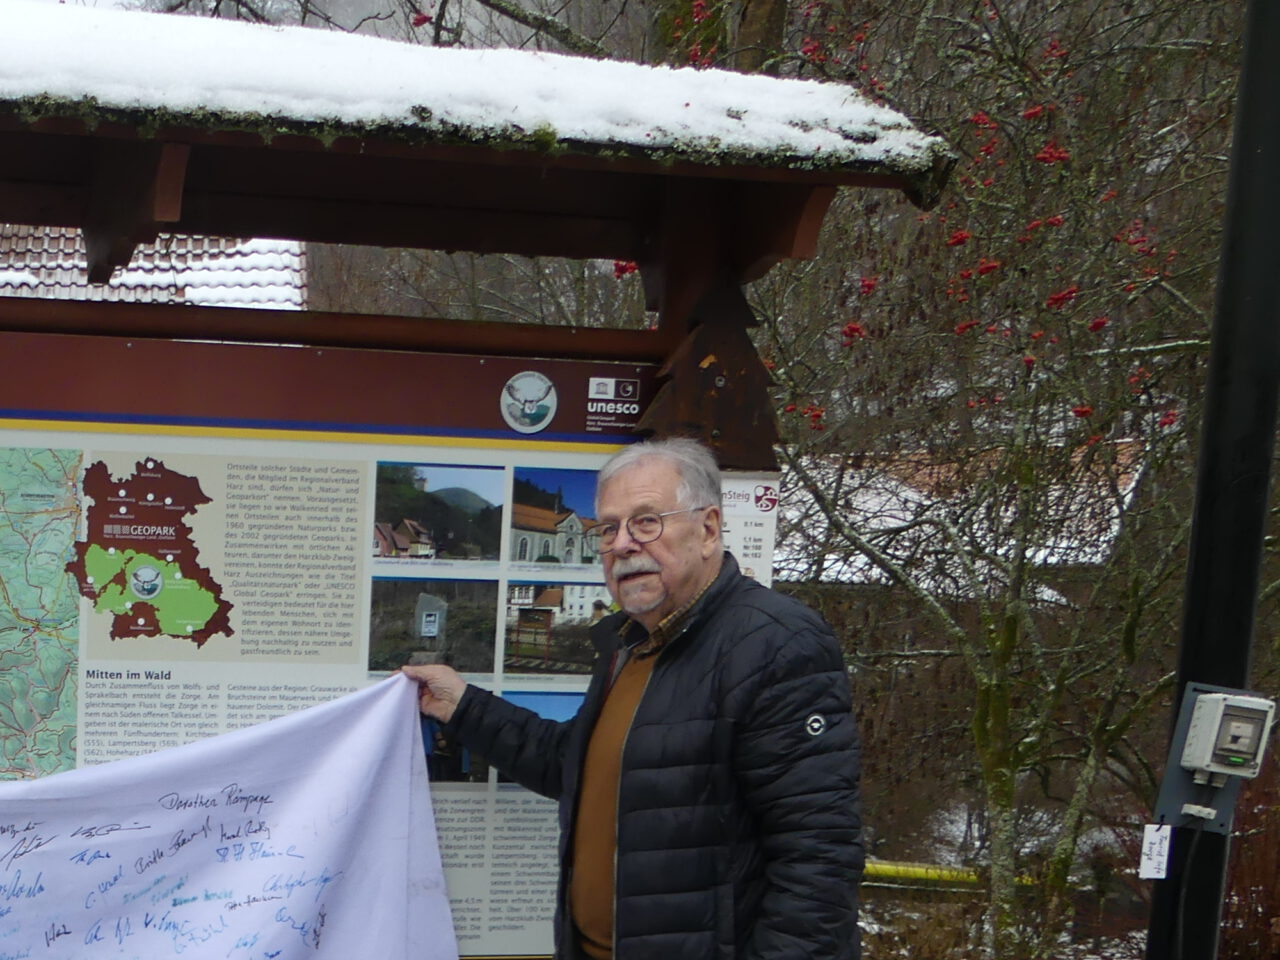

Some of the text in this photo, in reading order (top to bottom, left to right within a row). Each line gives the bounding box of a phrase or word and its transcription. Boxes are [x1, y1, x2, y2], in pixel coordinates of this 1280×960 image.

[588, 402, 638, 414] unesco
[722, 491, 750, 502] nSteig
[131, 525, 175, 535] GEOPARK
[86, 670, 171, 680] Mitten im Wald
